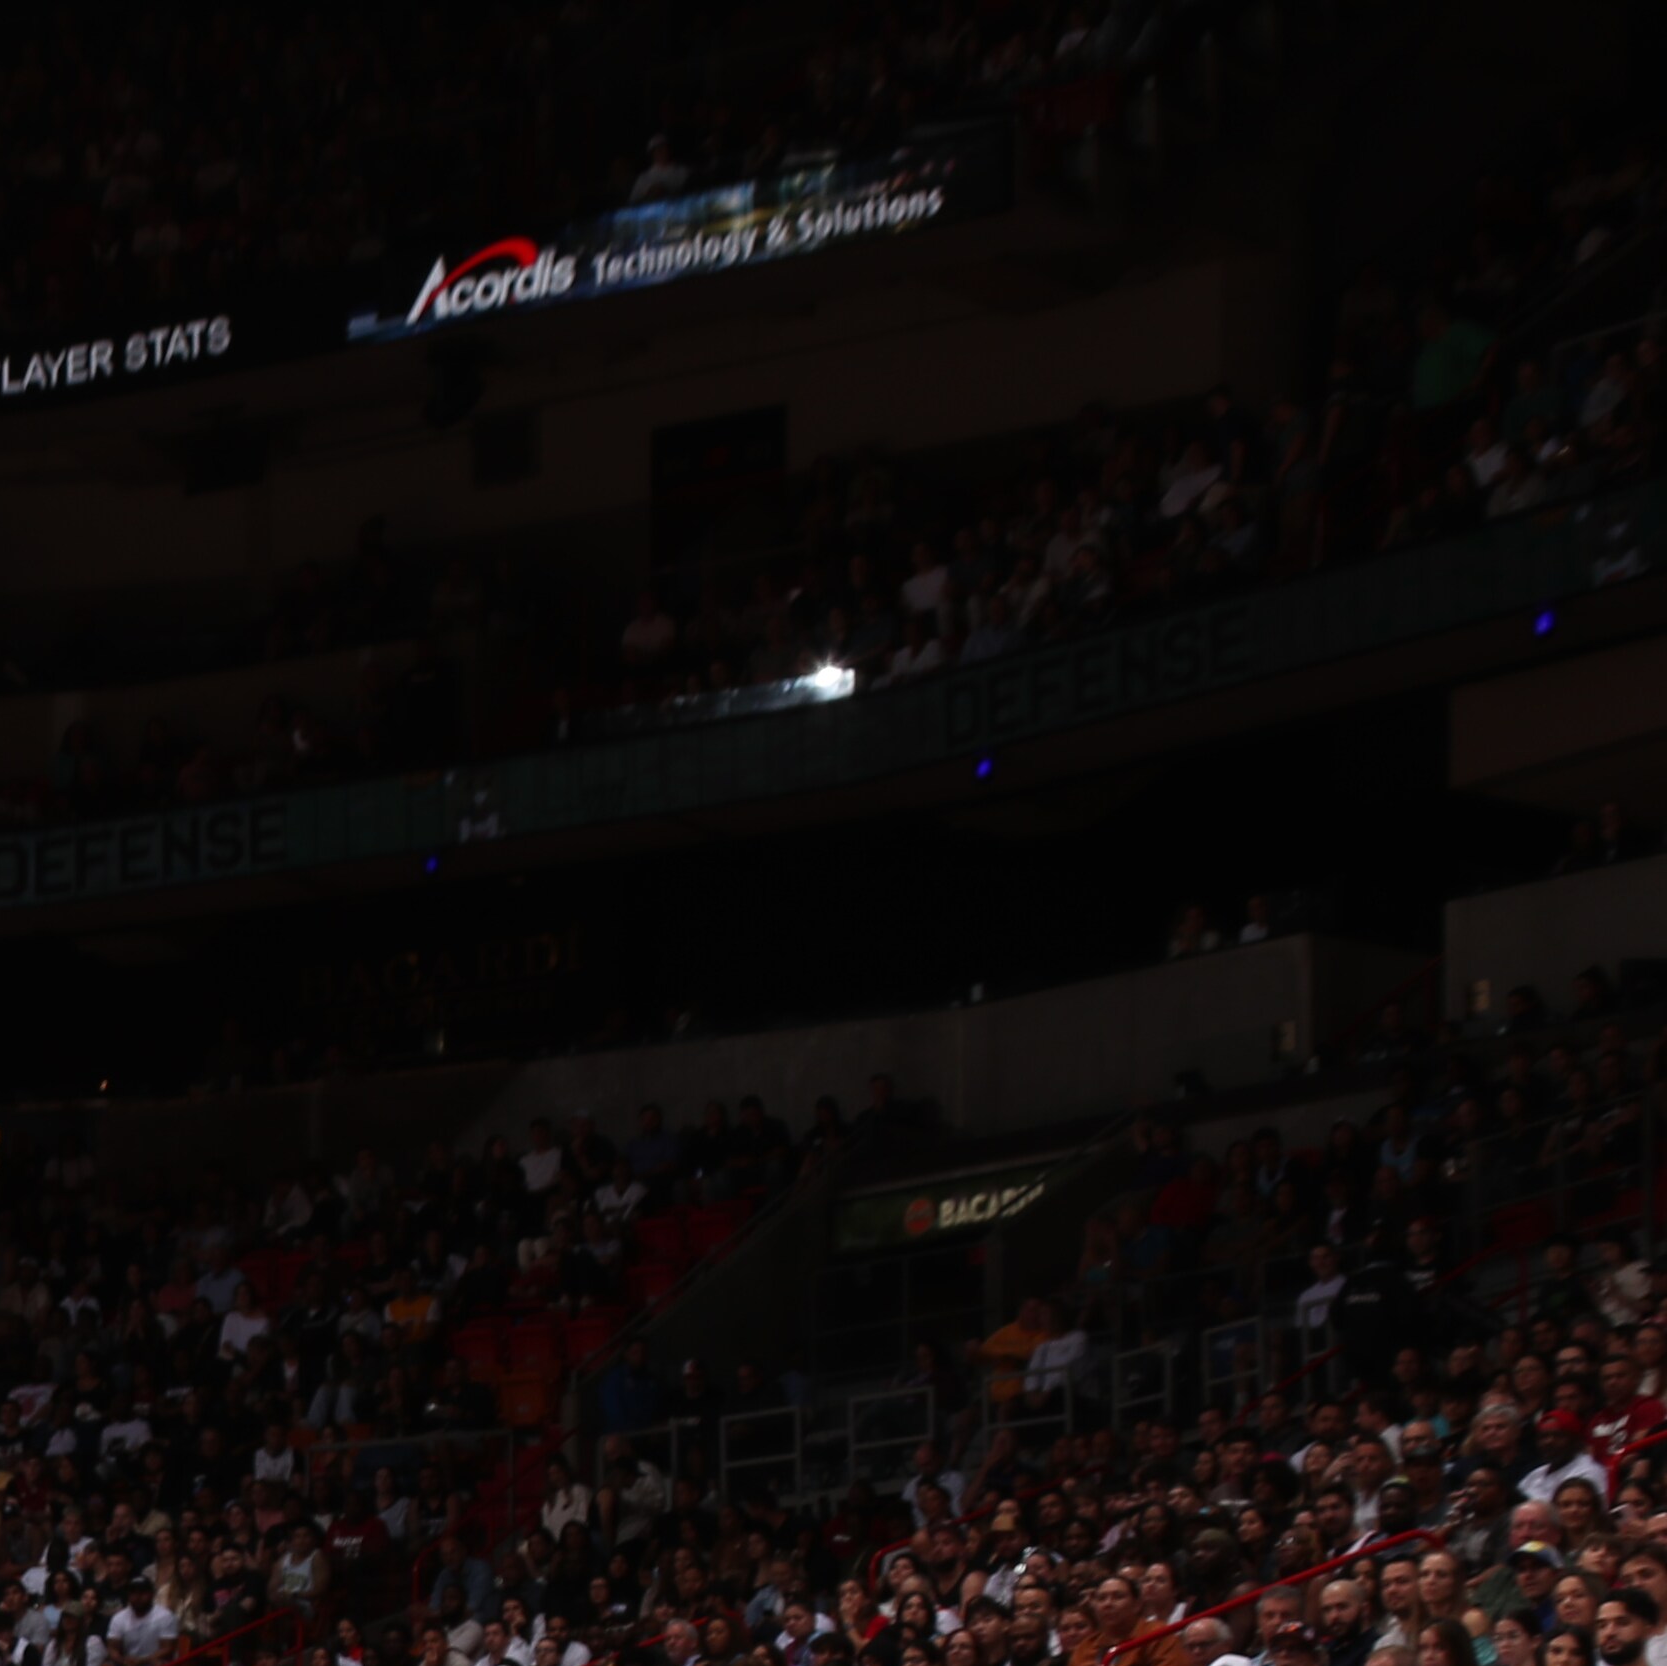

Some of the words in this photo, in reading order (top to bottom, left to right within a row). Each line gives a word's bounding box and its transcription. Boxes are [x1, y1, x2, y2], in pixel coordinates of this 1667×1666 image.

[405, 240, 577, 326] Acordis
[590, 222, 759, 286] Technology
[796, 185, 944, 241] Solutions
[123, 314, 233, 373] STATS
